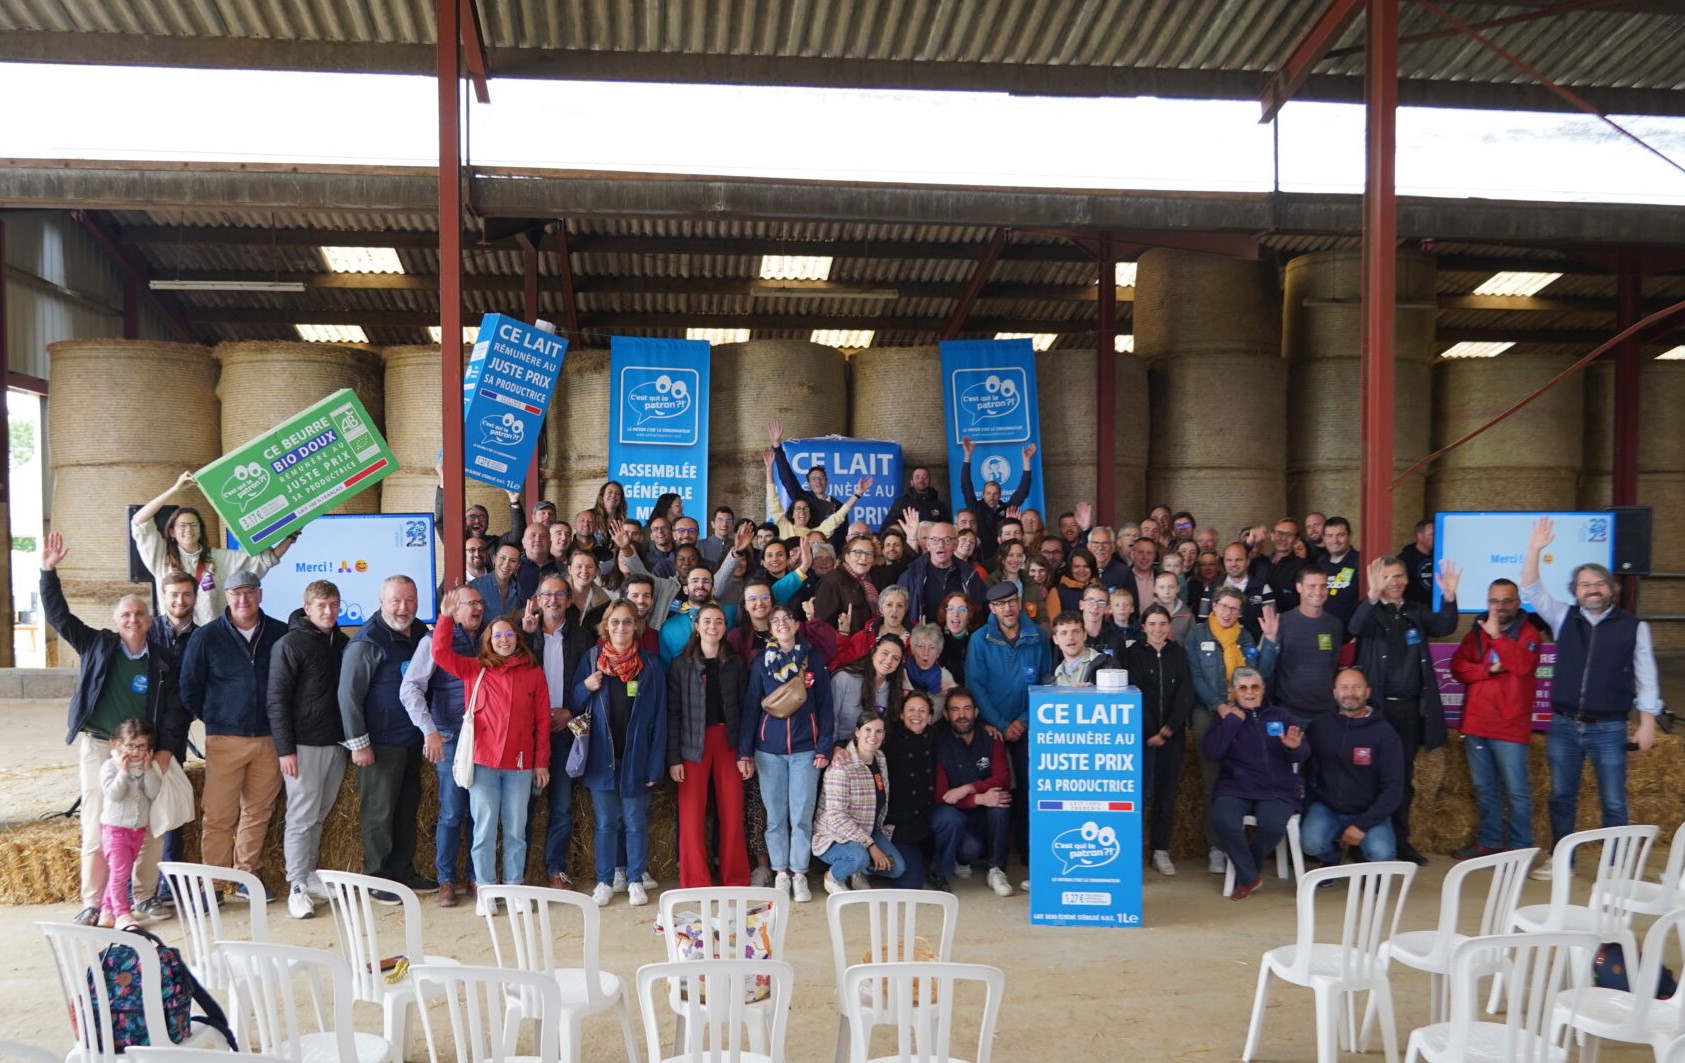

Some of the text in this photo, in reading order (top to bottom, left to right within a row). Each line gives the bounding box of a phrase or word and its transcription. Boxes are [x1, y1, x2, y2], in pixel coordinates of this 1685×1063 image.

[500, 324, 562, 358] CE LAIT
[494, 342, 542, 367] RÉMUNÈRE
[543, 362, 556, 372] AU
[489, 357, 524, 379] JUSTE
[525, 370, 551, 389] PRIX
[484, 374, 494, 385] SA
[496, 377, 546, 403] PRODUCTRICE
[264, 445, 282, 459] CE
[281, 416, 330, 450] BEURRE
[273, 453, 297, 472] BIO
[298, 430, 337, 457] DOUX
[279, 442, 344, 482] RÉMUNÈRE AU
[286, 451, 350, 493] JUSTE PRIX
[619, 462, 697, 479] ASSEMBLÉE
[792, 452, 894, 475] CE LAIT
[292, 461, 356, 502] SA PRODUCTRICE
[624, 482, 692, 500] GÉNÉRALE
[875, 485, 895, 497] AU
[224, 488, 237, 498] C'est
[296, 561, 326, 572] Merci
[1491, 554, 1518, 563] Merci
[1037, 704, 1134, 724] CE LAIT
[1037, 731, 1134, 745] RÉMUNÈRE AU
[1037, 753, 1134, 771] JUSTE PRIX
[1037, 779, 1134, 792] SA PRODUCTRICE
